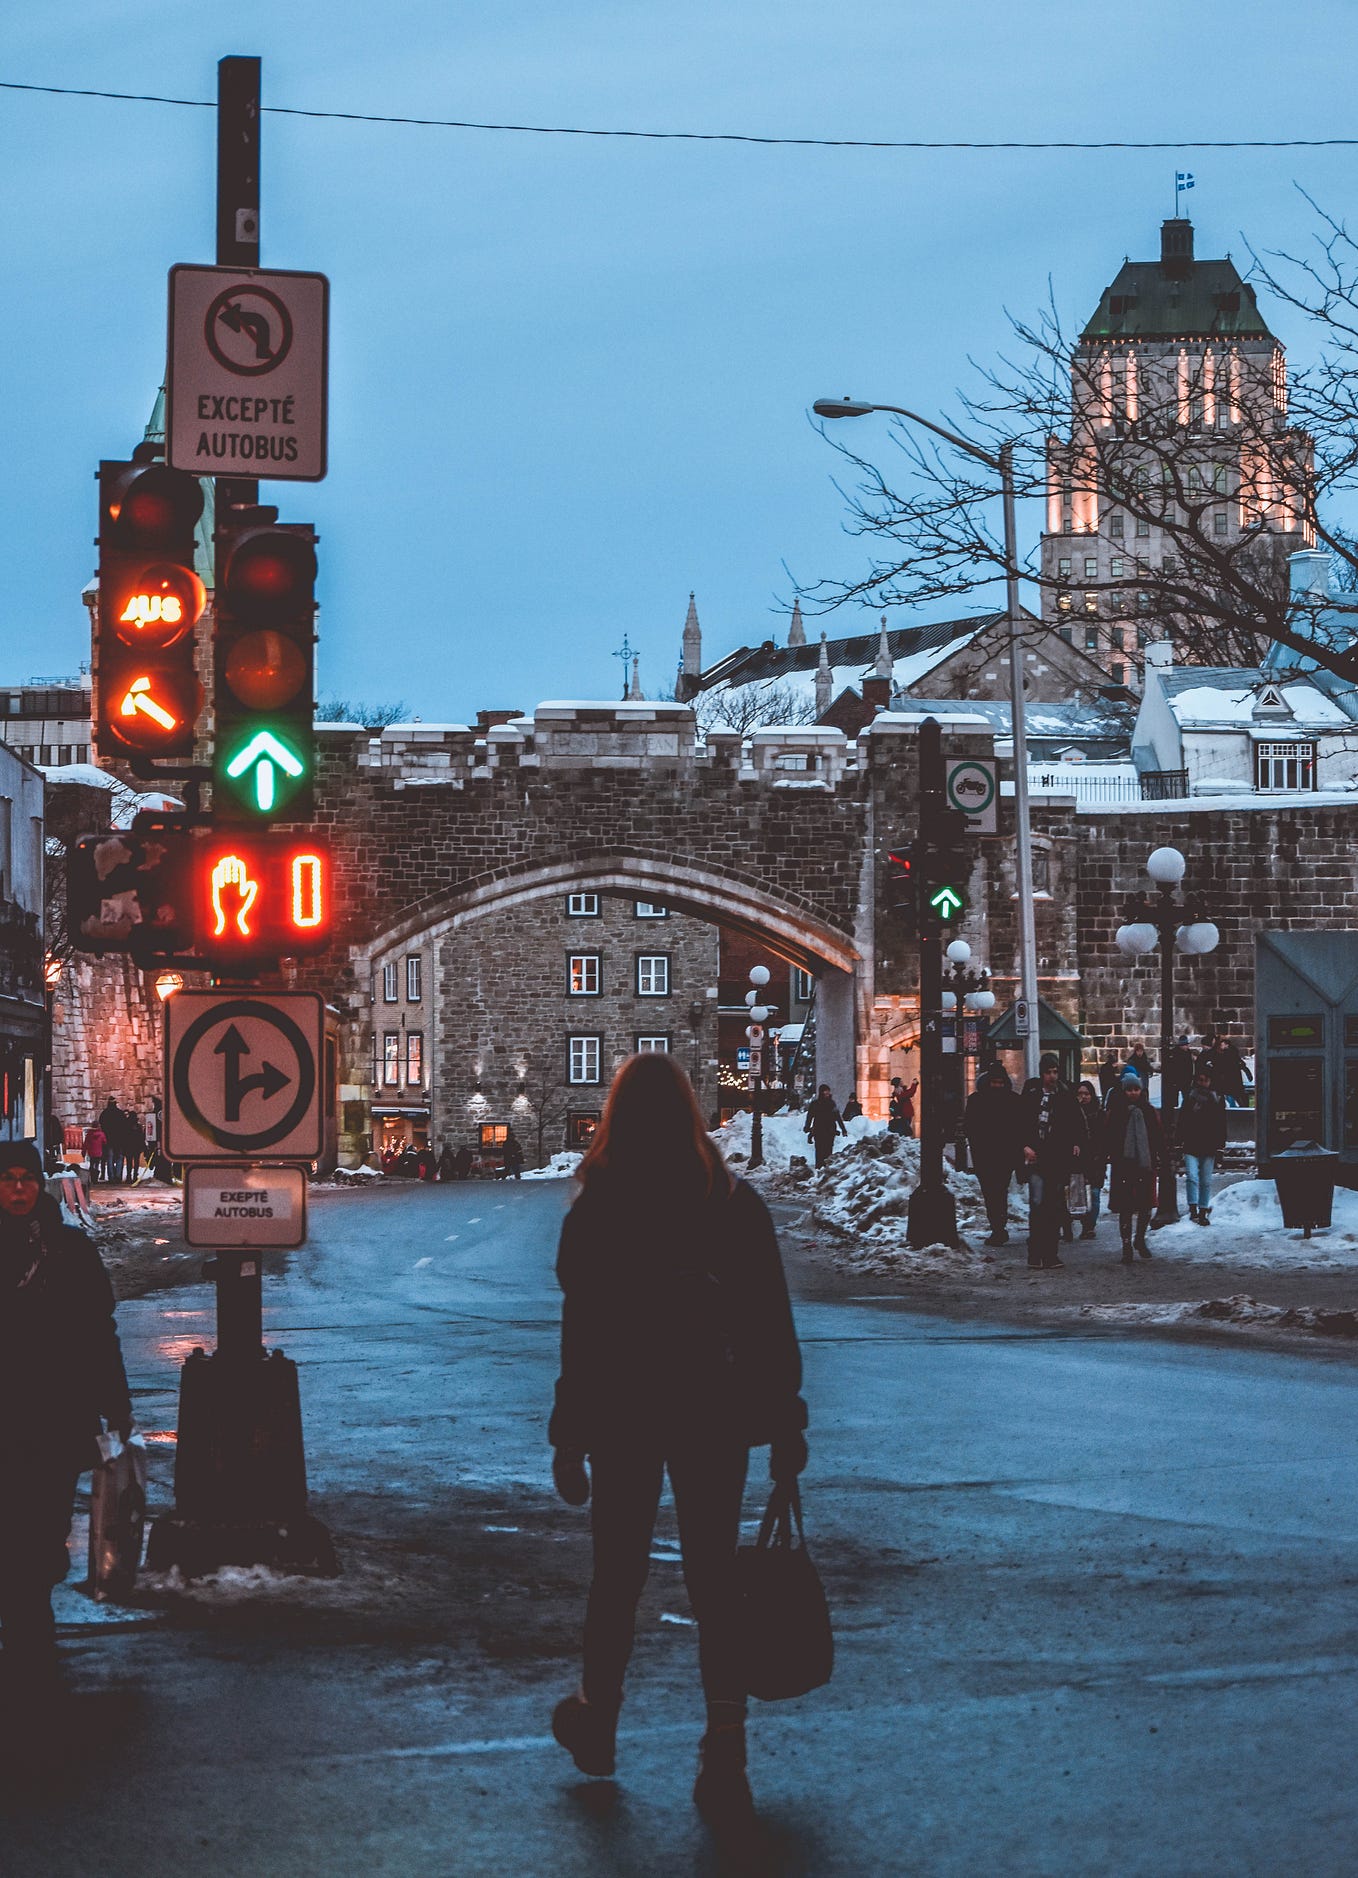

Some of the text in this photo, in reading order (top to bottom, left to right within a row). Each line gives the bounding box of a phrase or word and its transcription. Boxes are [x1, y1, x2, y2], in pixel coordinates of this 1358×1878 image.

[197, 394, 295, 425] EXCEPTÉ
[196, 432, 299, 462] AUTOBUS
[220, 1190, 268, 1202] EXEPTÉ
[215, 1207, 273, 1217] AUTOBUS
